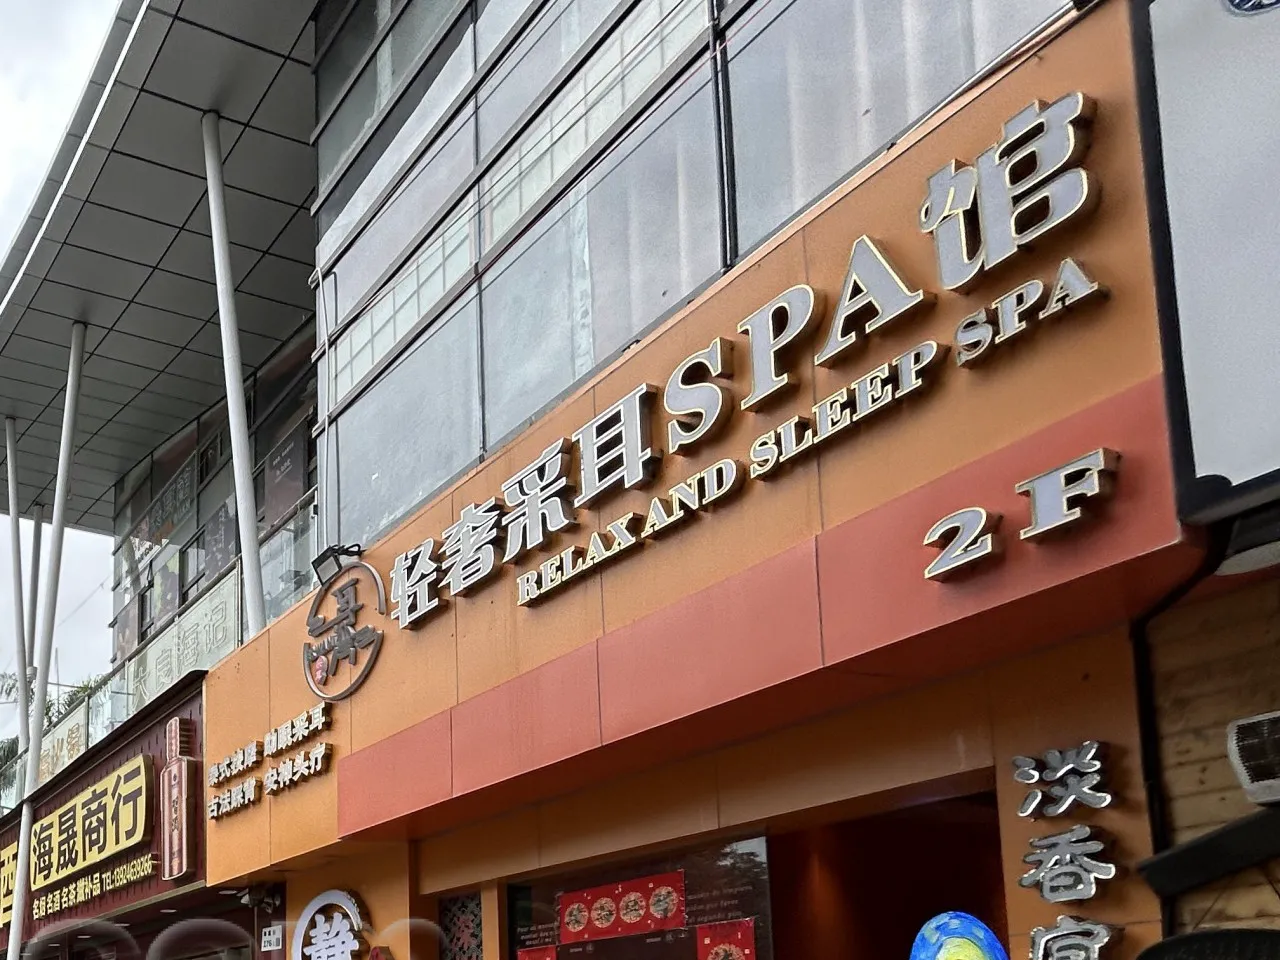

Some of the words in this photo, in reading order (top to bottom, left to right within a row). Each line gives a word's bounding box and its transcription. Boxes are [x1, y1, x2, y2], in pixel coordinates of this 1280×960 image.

[517, 511, 636, 607] RELAX
[640, 457, 738, 544] AND
[749, 340, 941, 479] SLEEP
[954, 257, 1099, 366] SPA
[32, 765, 144, 886] 海晟商行
